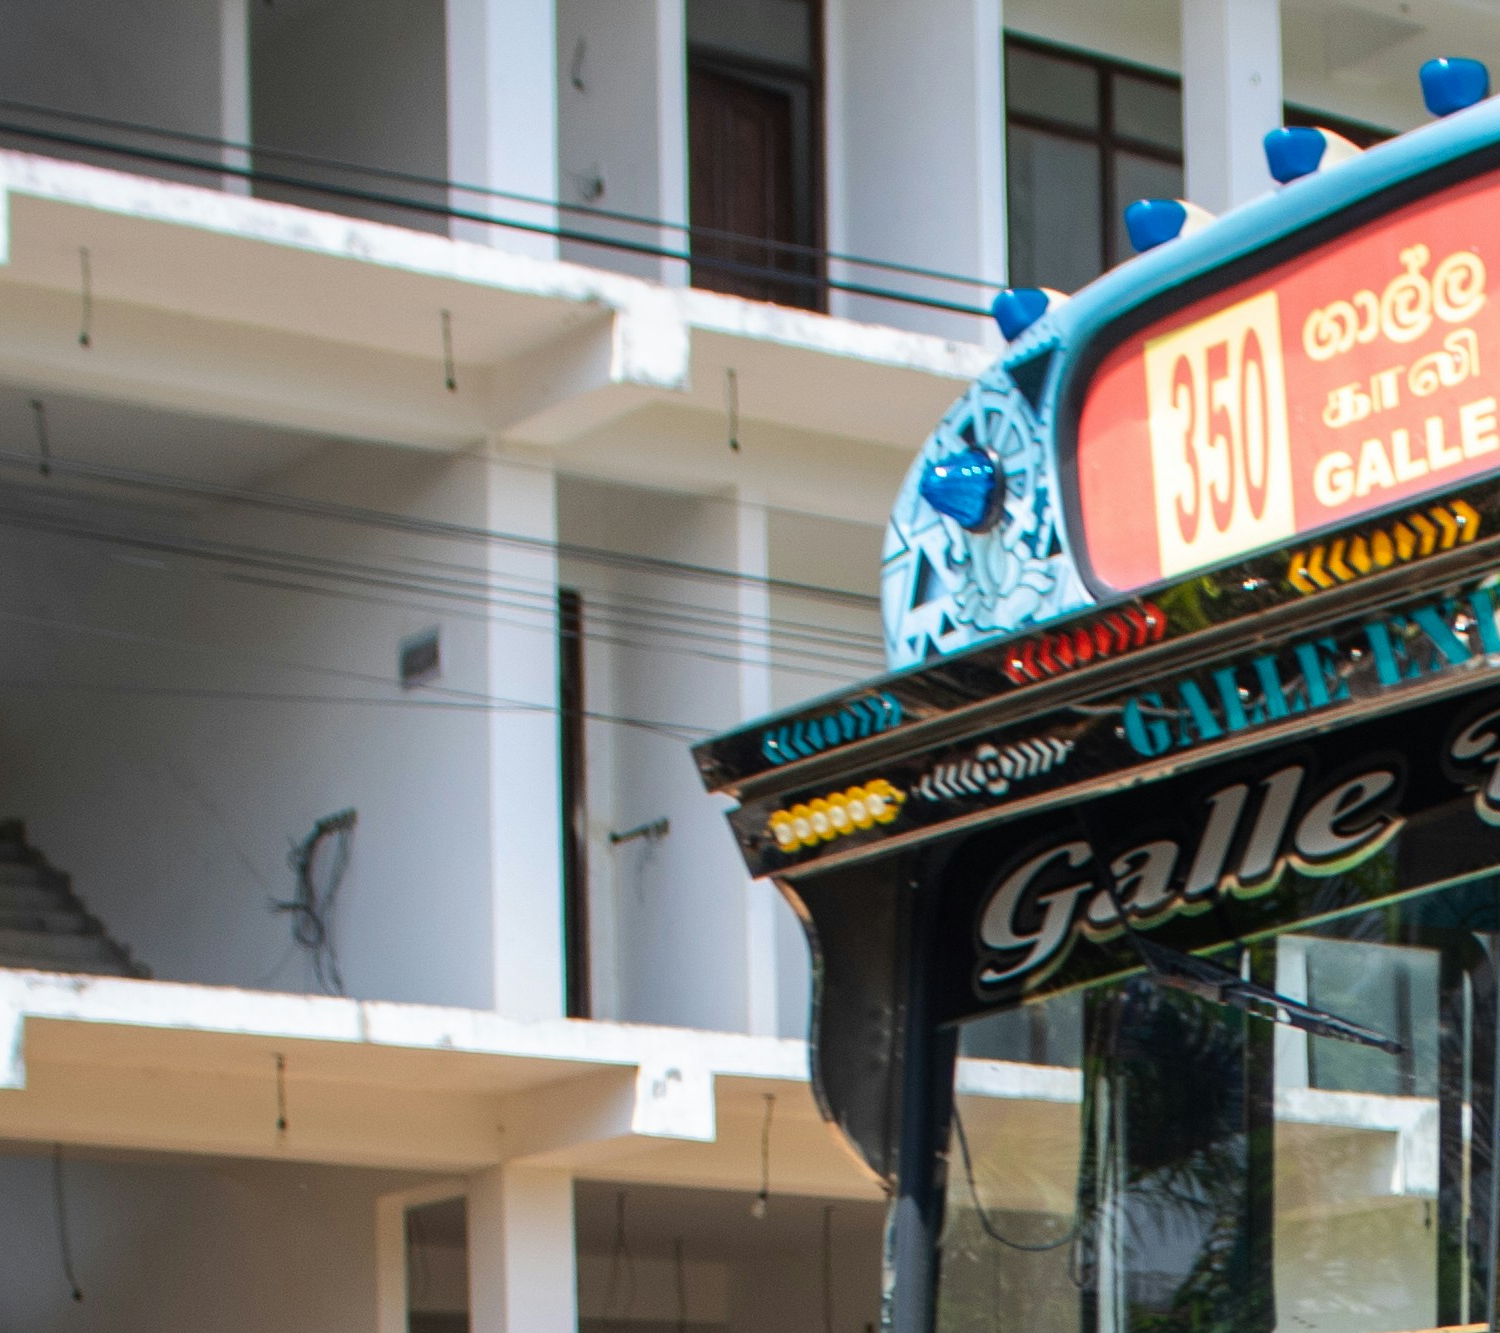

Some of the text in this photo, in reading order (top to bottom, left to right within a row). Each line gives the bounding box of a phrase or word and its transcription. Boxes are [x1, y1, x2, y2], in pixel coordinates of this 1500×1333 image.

[1302, 243, 1488, 361] ගාල්ල
[1170, 326, 1270, 545] 350
[1322, 327, 1481, 429] காலி
[1312, 396, 1500, 508] GALLE
[1124, 637, 1355, 757] GALLE
[978, 762, 1400, 988] Galle
